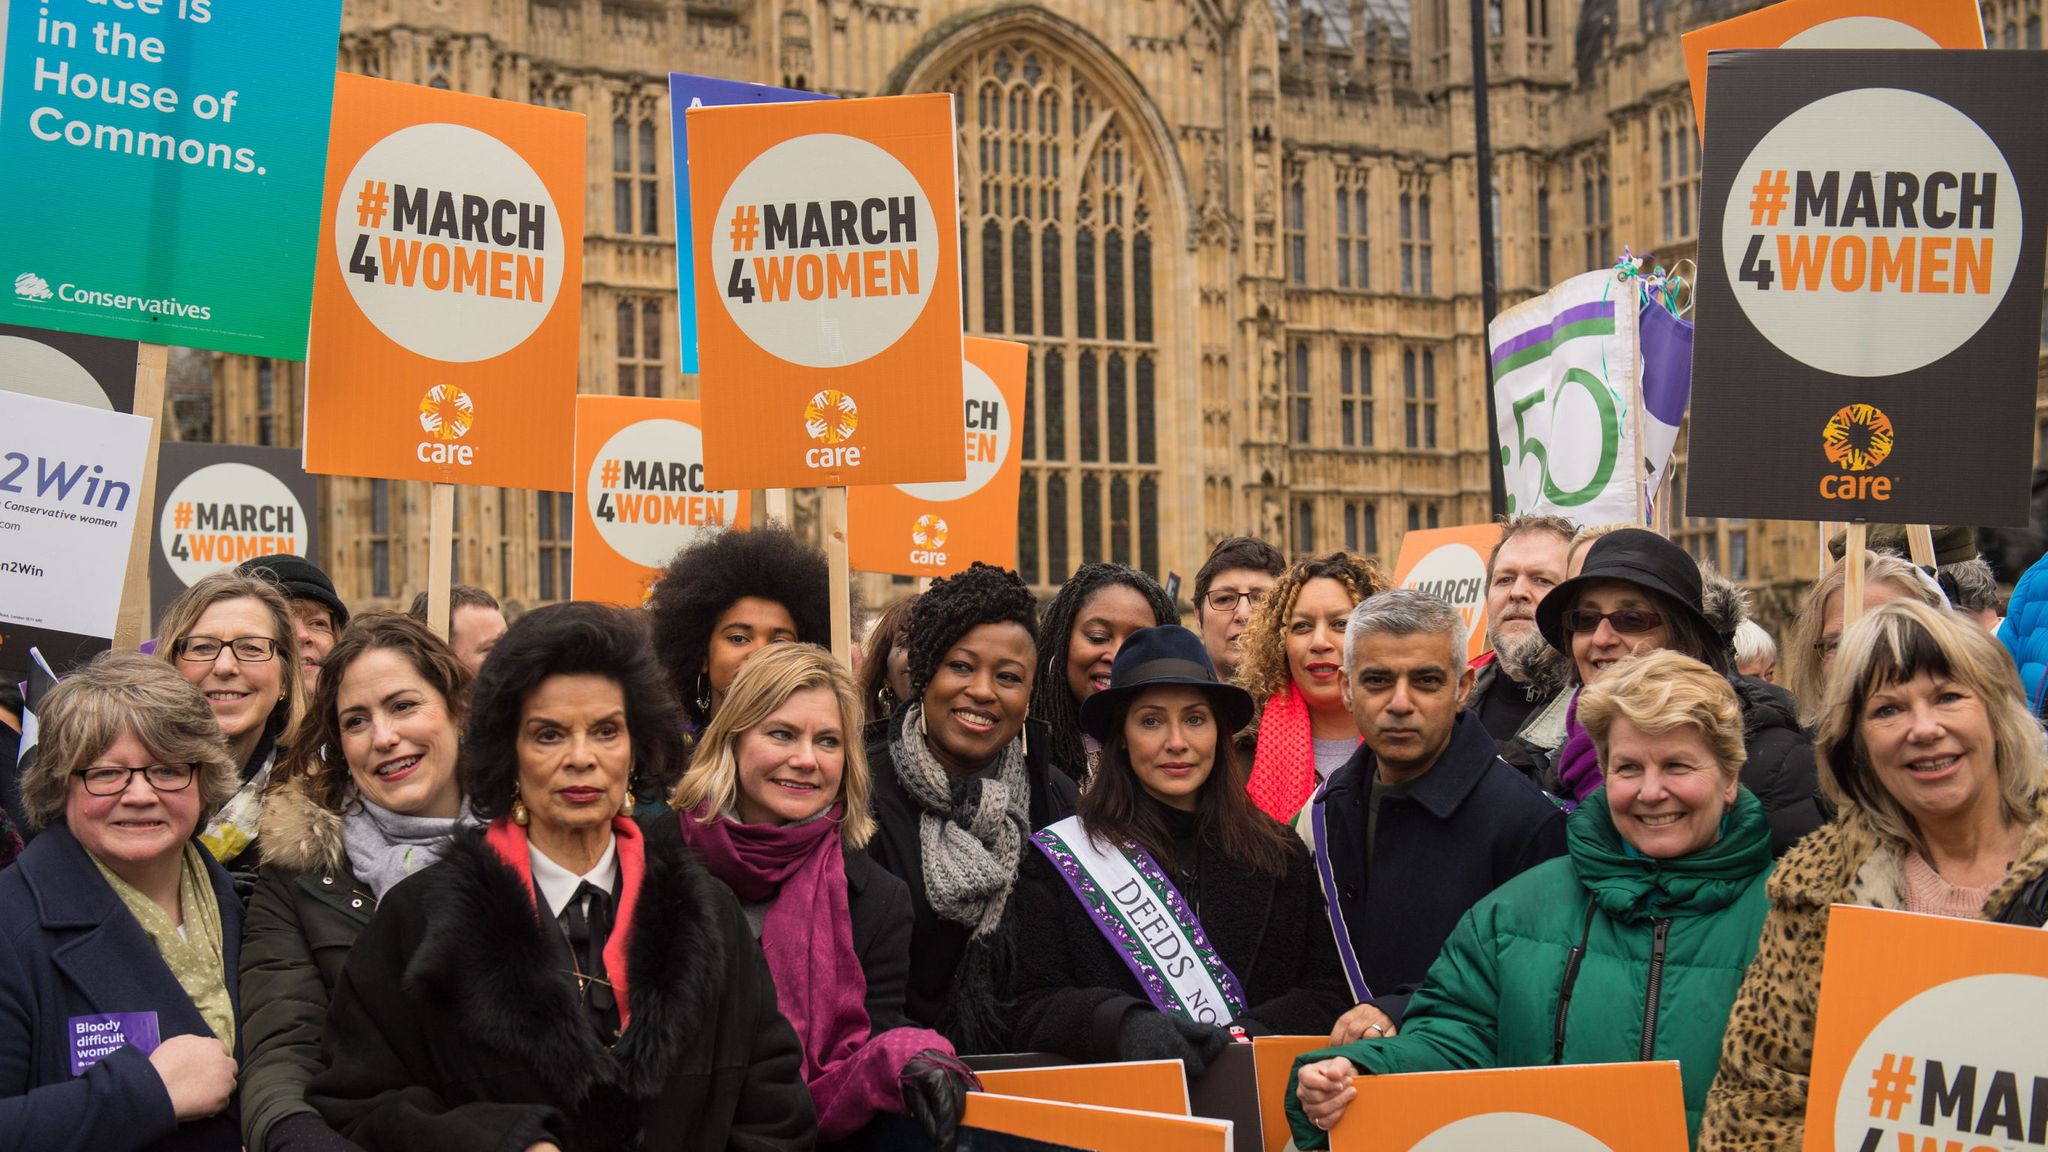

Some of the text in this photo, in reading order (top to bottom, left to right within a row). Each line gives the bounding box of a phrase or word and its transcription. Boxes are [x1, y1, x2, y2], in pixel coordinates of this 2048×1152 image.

[38, 7, 165, 63] in the
[34, 57, 239, 123] House of
[29, 106, 266, 175] Commons.
[357, 179, 545, 251] #MARCH
[1749, 170, 1997, 229] #MARCH
[730, 196, 917, 252] #MARCH
[349, 233, 545, 304] 4WOMEN
[728, 248, 920, 304] 4WOMEN
[1739, 234, 1994, 294] 4WOMEN
[58, 283, 212, 320] Conservatives
[417, 441, 474, 466] care
[805, 446, 861, 469] care
[0, 451, 131, 512] 2Win
[601, 458, 724, 493] #MARC
[1819, 474, 1892, 501] care
[4, 500, 118, 528] Conservative women
[174, 501, 294, 534] #MARCH
[596, 493, 724, 527] 4WOMEN
[171, 533, 295, 563] 4WOMEN
[909, 549, 947, 566] care
[0, 561, 44, 577] n2Win
[1111, 877, 1195, 978] DEEDS
[1186, 988, 1222, 1028] NO
[76, 1020, 121, 1034] Bloody
[77, 1033, 125, 1047] difficult
